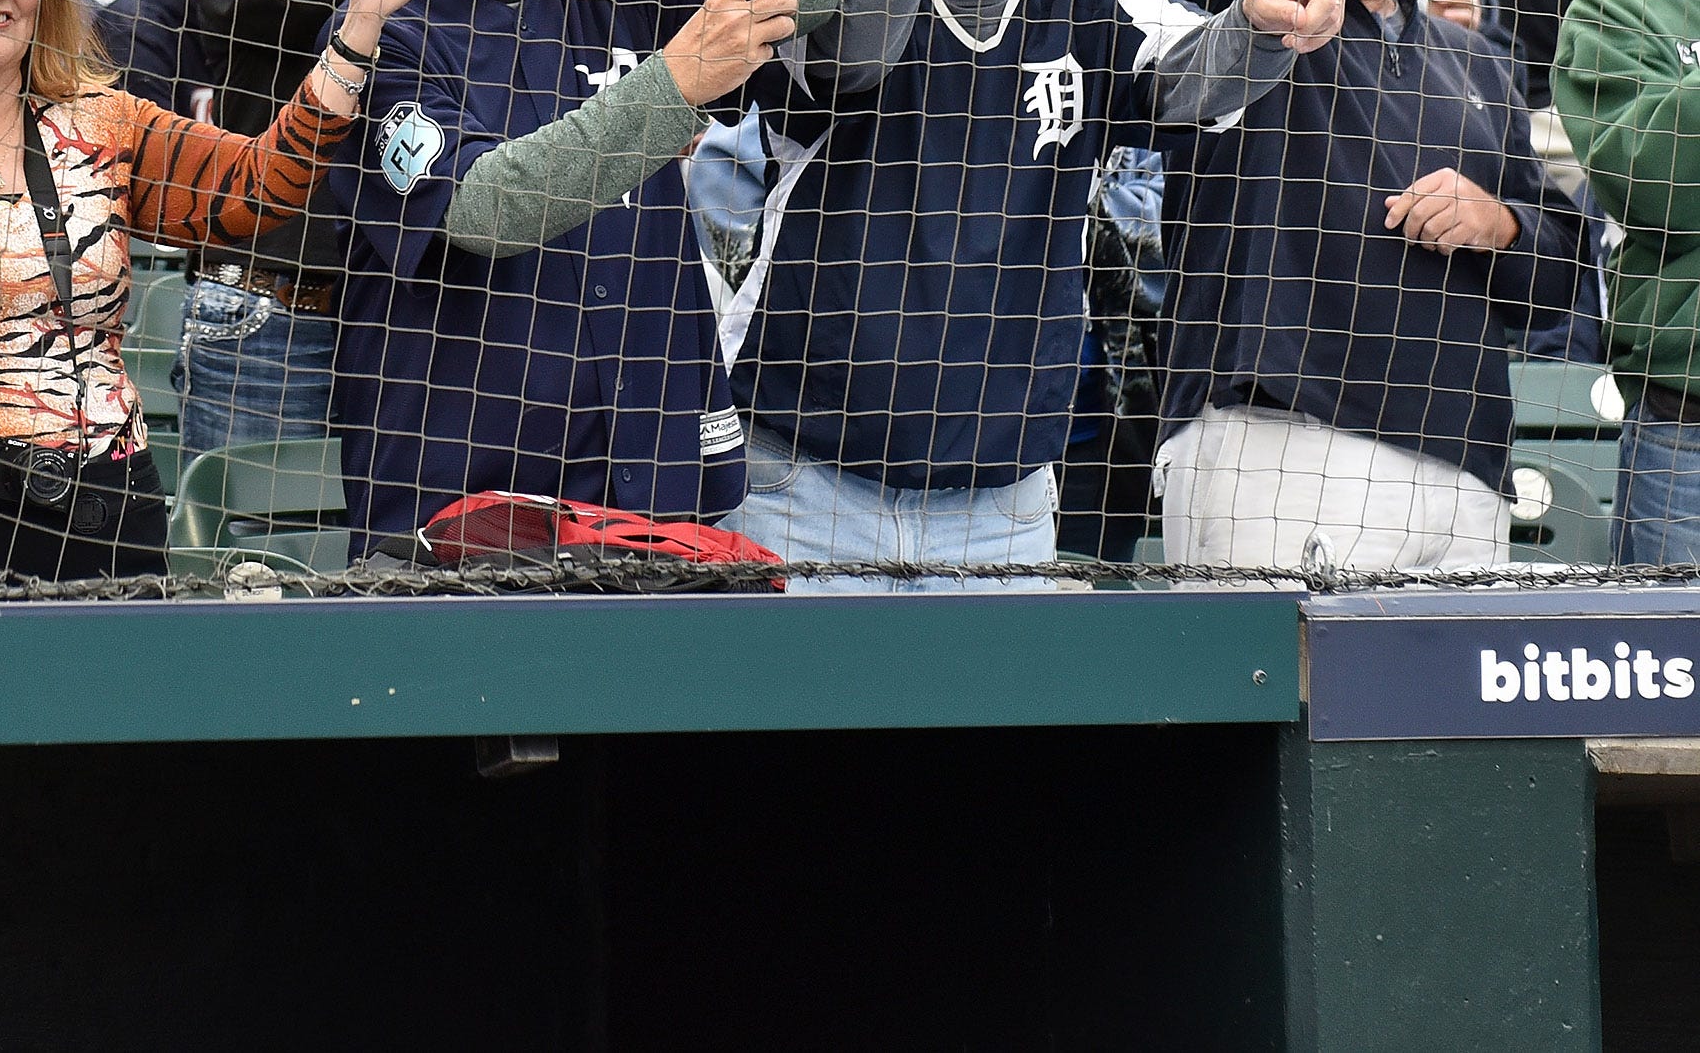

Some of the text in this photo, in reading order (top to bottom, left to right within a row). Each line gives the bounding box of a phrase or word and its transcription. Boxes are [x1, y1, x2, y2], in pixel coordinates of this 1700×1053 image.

[390, 139, 425, 175] FL
[7, 439, 29, 449] SONY
[1480, 641, 1695, 703] bitbits
